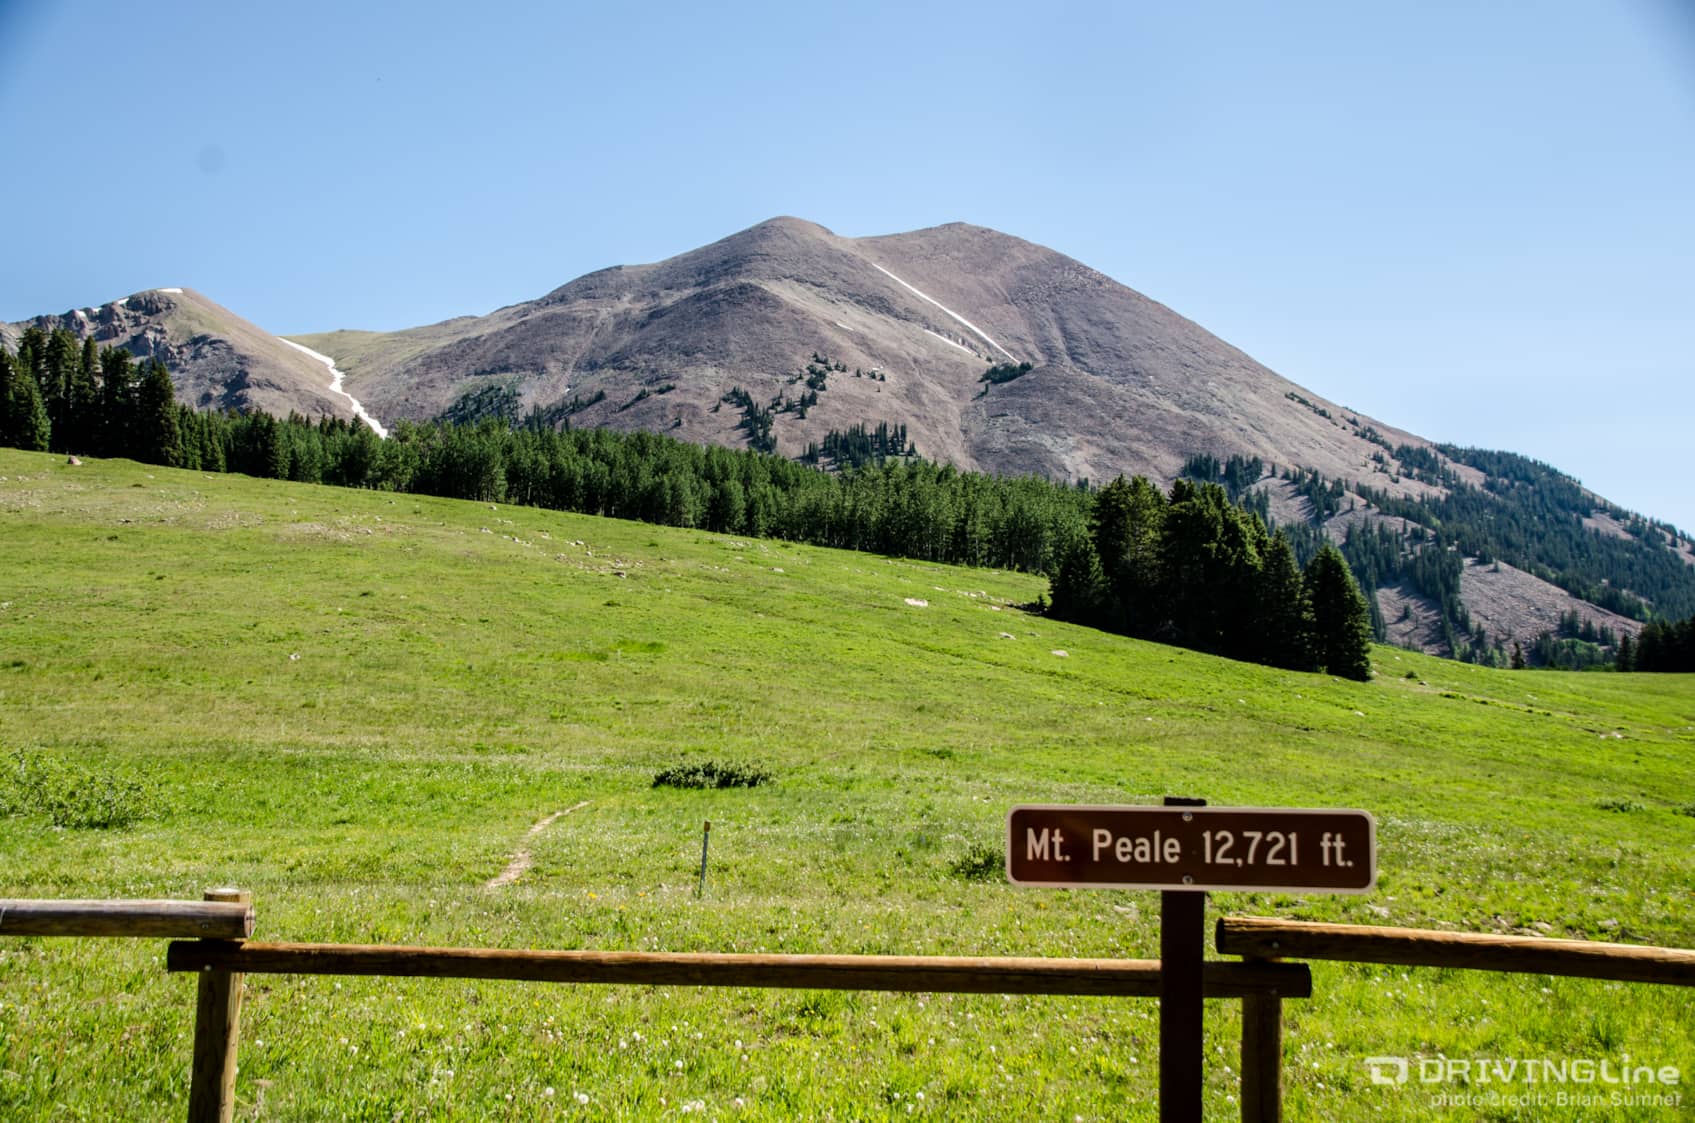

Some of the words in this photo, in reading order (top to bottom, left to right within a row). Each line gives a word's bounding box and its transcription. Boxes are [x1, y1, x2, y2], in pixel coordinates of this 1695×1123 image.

[1026, 827, 1071, 861] Mt.
[1092, 828, 1181, 863] Peale
[1202, 830, 1297, 867] 12,721
[1320, 832, 1354, 867] ft.
